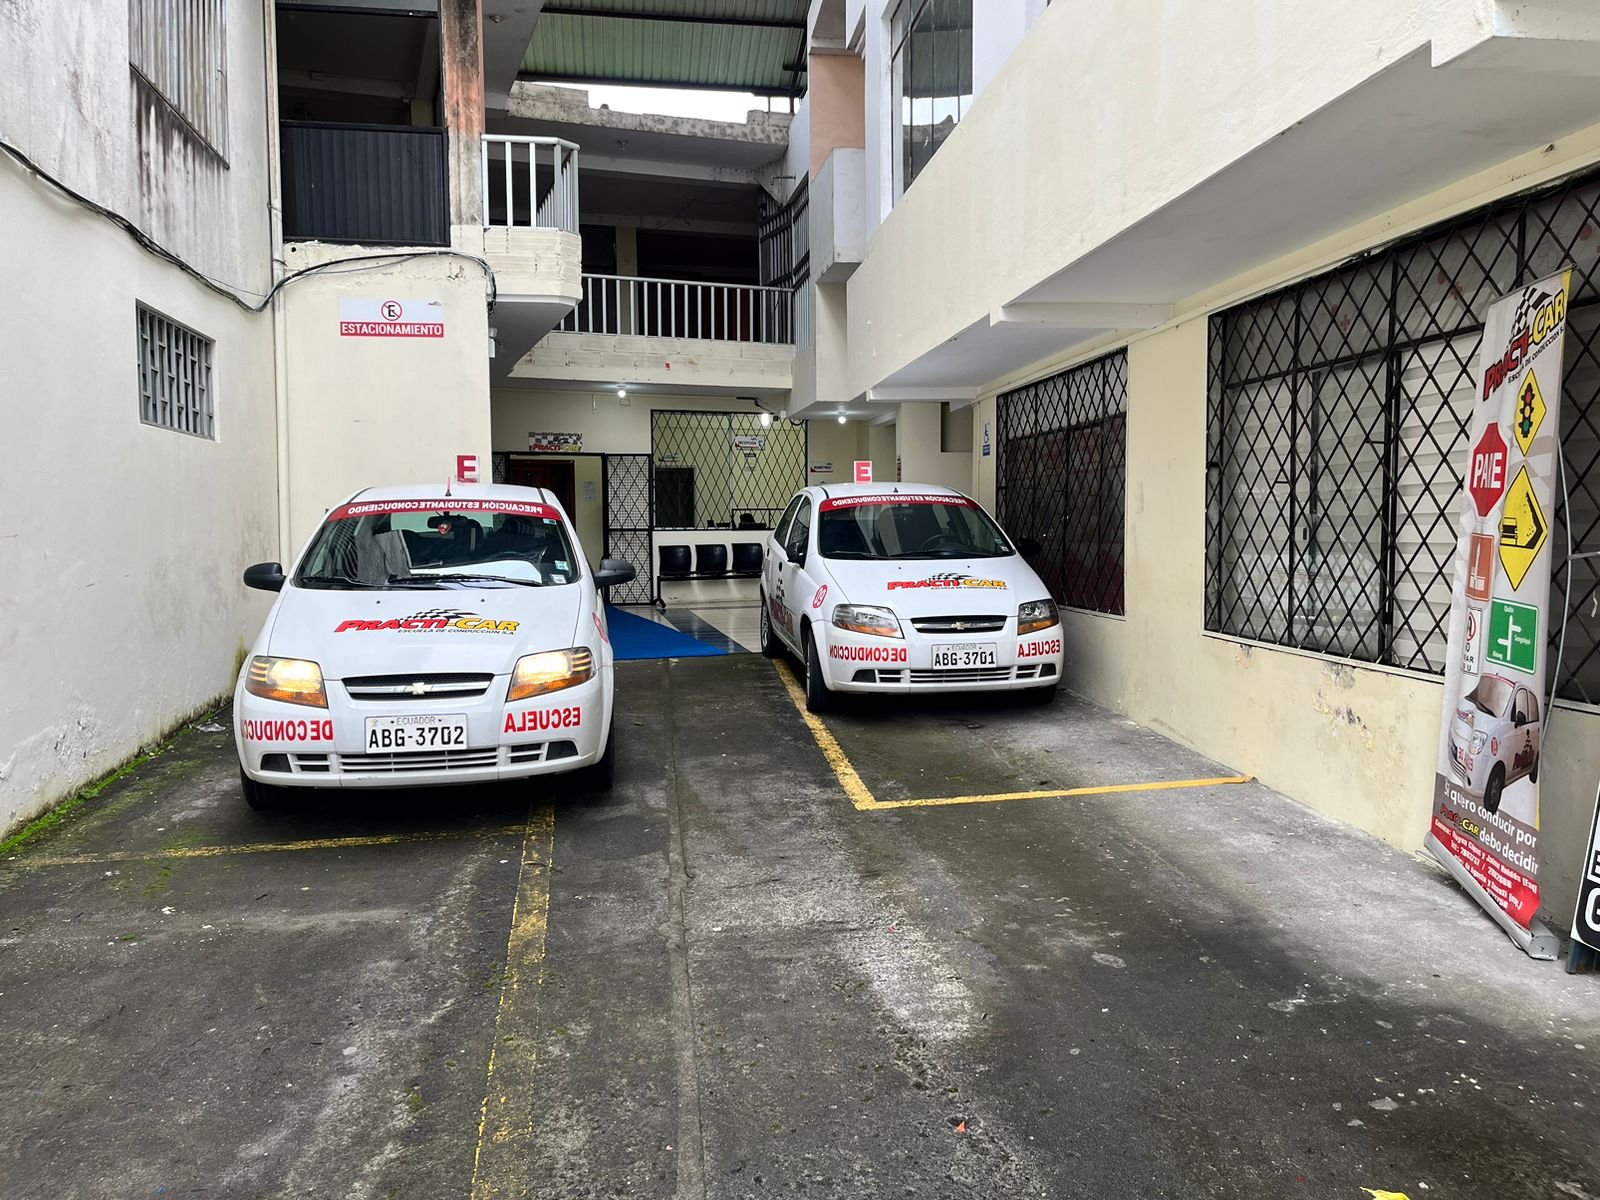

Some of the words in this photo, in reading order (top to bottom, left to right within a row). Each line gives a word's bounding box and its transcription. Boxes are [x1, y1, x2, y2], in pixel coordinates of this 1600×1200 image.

[341, 323, 442, 336] ESTACIONAMIENTO
[457, 455, 477, 483] E
[856, 462, 871, 481] E
[333, 617, 520, 633] PRACTI-CAR
[934, 651, 996, 667] ABG-3701
[396, 716, 437, 726] ECUADOR
[368, 725, 465, 750] ABG-3702
[1477, 805, 1516, 837] conducir
[1515, 827, 1537, 849] por
[1479, 827, 1501, 852] debo
[1501, 842, 1539, 875] decidir
